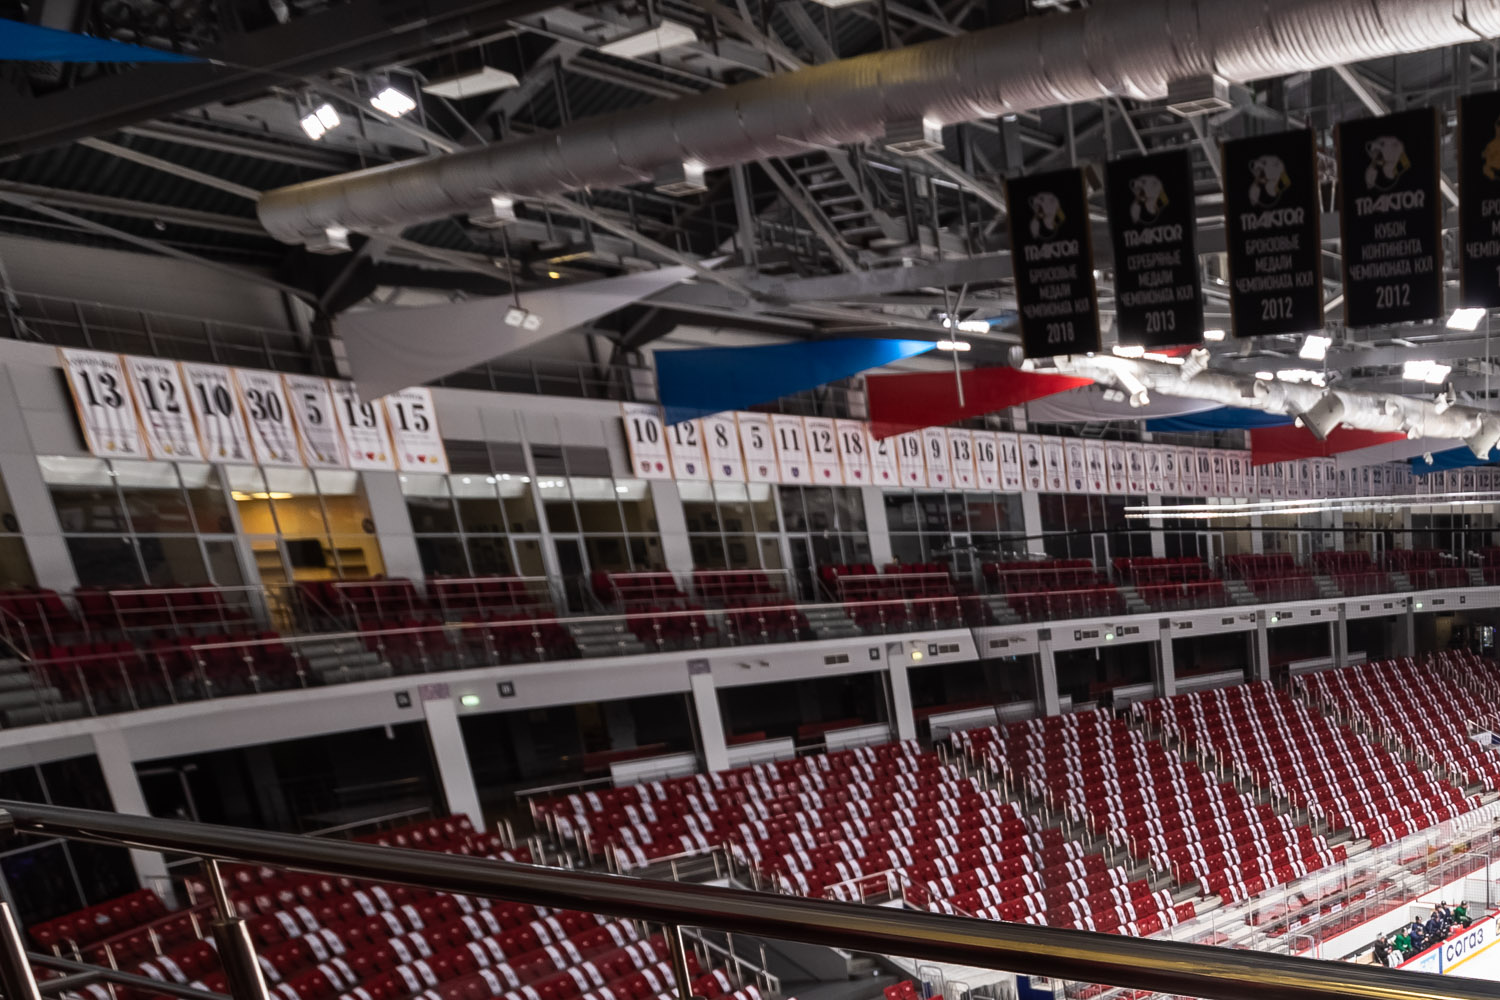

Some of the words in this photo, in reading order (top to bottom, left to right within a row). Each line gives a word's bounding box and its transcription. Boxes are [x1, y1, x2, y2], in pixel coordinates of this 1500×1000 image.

[1355, 191, 1425, 216] TRAKTOR
[1240, 208, 1304, 231] TRAKTOR
[1374, 221, 1406, 239] КУБОК
[1124, 224, 1183, 247] TRAKTOR
[1245, 234, 1299, 255] БРОНЗОВЫЕ
[1024, 240, 1079, 263] TRAKTOR
[1361, 239, 1422, 259] КОНТИНЕНТА
[1255, 256, 1292, 273] МЕДАЛИ
[1349, 259, 1411, 280] ЧЕМПИОНАТА
[1414, 256, 1433, 274] КХЛ
[1138, 269, 1173, 287] МЕДАЛИ
[1236, 274, 1293, 293] ЧЕМПИОНАТА
[1295, 271, 1314, 288] КХЛ
[1376, 283, 1410, 309] 2012
[1261, 296, 1293, 320] 2012
[1046, 321, 1075, 344] 2018
[1145, 309, 1176, 333] 2013
[79, 370, 124, 408] 13
[140, 377, 180, 413] 12
[195, 382, 233, 417] 10
[247, 389, 282, 421] 30
[305, 393, 323, 424] 5
[344, 399, 377, 428] 19
[396, 402, 429, 432] 15
[633, 418, 658, 443] 10
[675, 421, 697, 446] 12
[715, 424, 728, 448] 8
[751, 426, 763, 449] 5
[780, 428, 800, 451] 11
[812, 430, 832, 453] 12
[843, 432, 863, 455] 18
[901, 437, 918, 457] 19
[931, 439, 940, 458] 9
[953, 440, 970, 460] 13
[979, 442, 994, 462] 16
[1002, 444, 1017, 464] 14
[1198, 456, 1209, 473] 10
[1214, 457, 1224, 474] 21
[1230, 459, 1240, 475] 13
